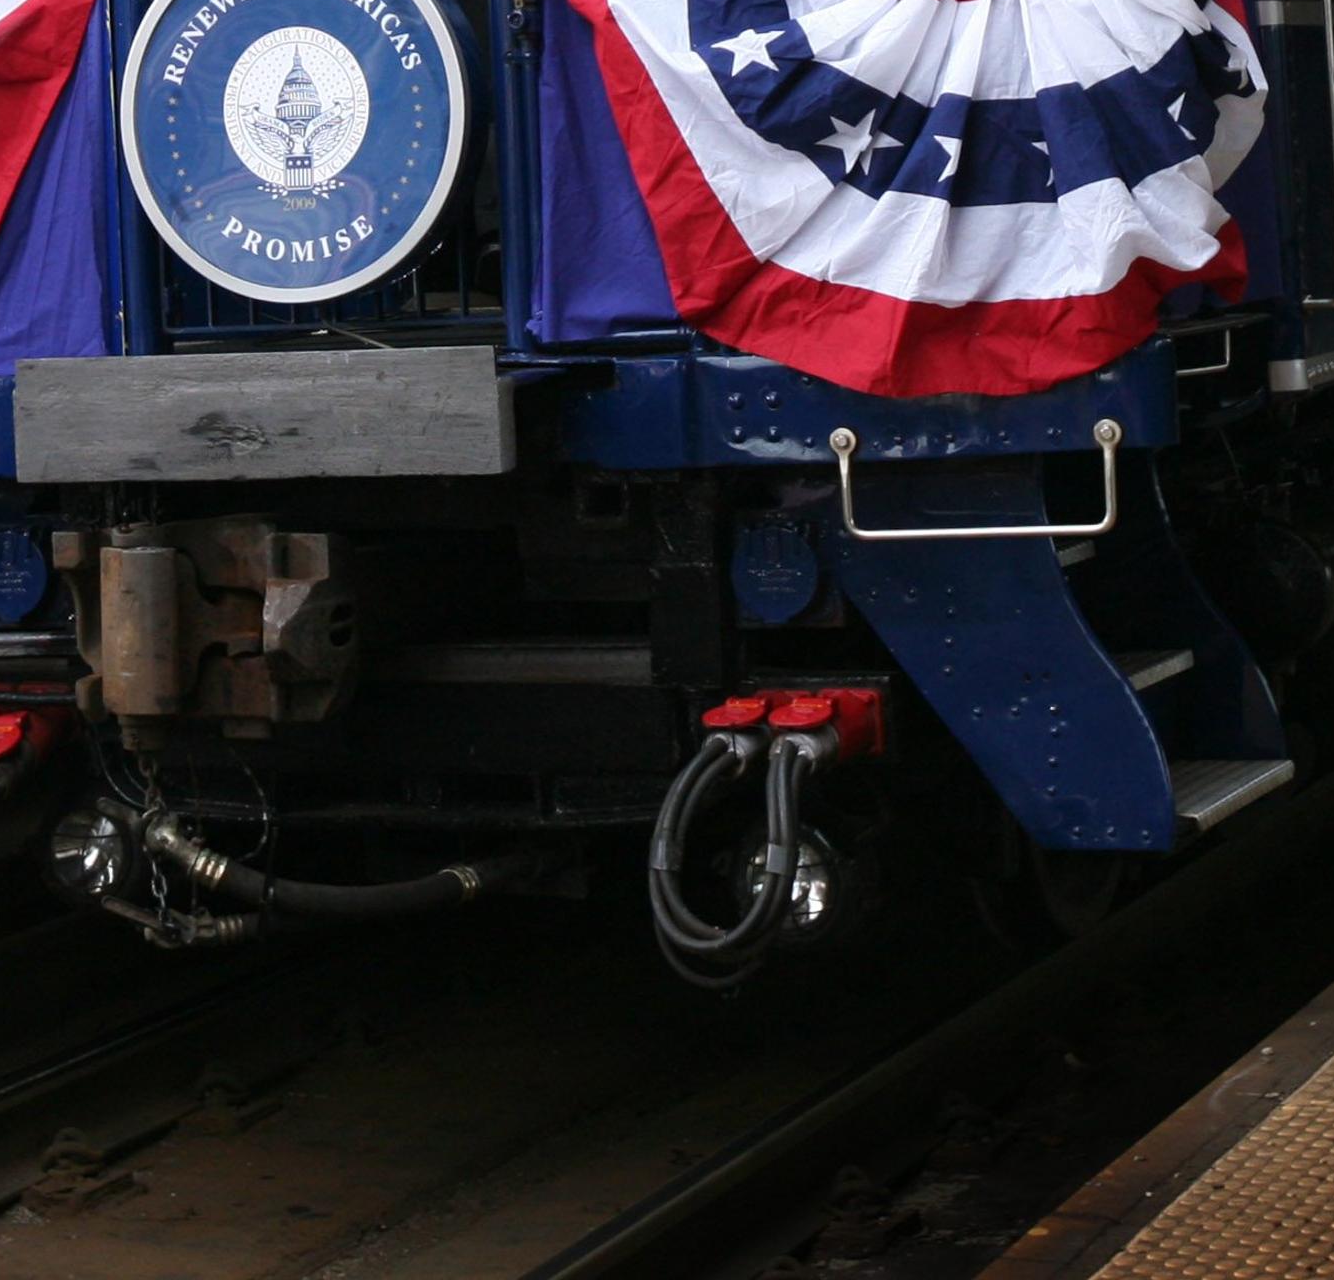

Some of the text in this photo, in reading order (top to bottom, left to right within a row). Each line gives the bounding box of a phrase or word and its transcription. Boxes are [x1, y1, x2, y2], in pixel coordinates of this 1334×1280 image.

[238, 28, 354, 71] INAUGURATION OF
[226, 81, 255, 169] PRESIDENT
[254, 165, 282, 183] AND
[316, 155, 347, 182] VICE
[283, 196, 317, 211] 2009
[220, 213, 375, 263] PROMISE
